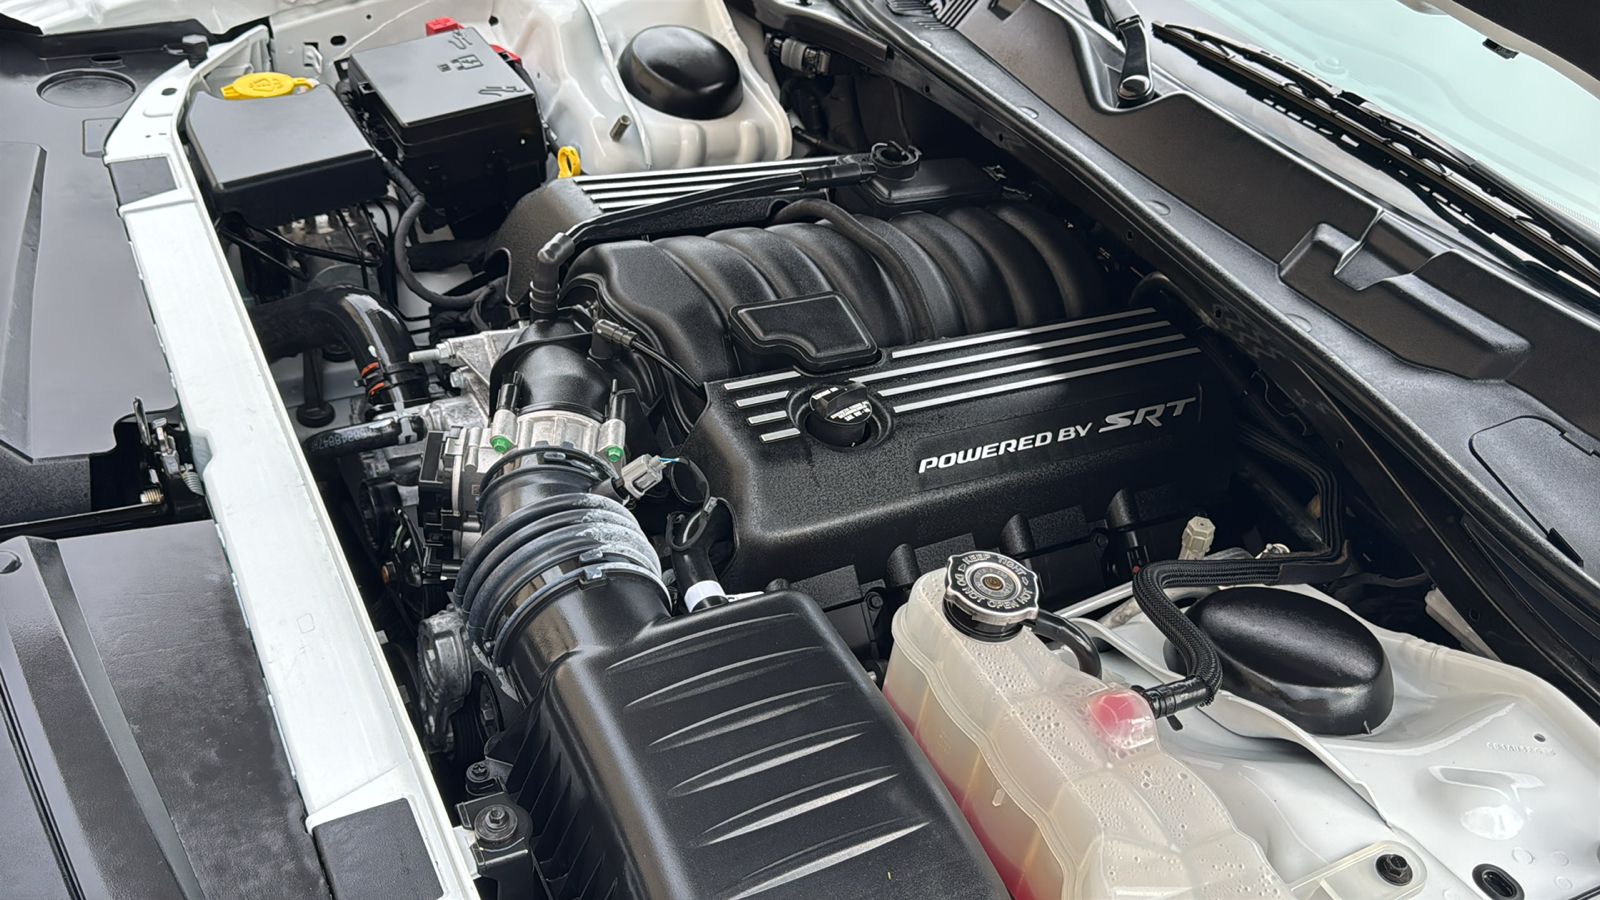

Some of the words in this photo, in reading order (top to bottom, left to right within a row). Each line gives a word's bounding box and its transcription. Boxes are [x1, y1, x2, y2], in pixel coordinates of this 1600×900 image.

[918, 431, 1053, 474] POWERED
[1057, 422, 1093, 442] BY
[1098, 396, 1197, 433] SRT
[962, 553, 991, 565] KEEP
[997, 555, 1027, 576] TIGHT
[954, 573, 967, 587] DO
[962, 587, 986, 603] NOT
[987, 600, 1020, 610] OPEN
[1017, 587, 1033, 605] HOT
